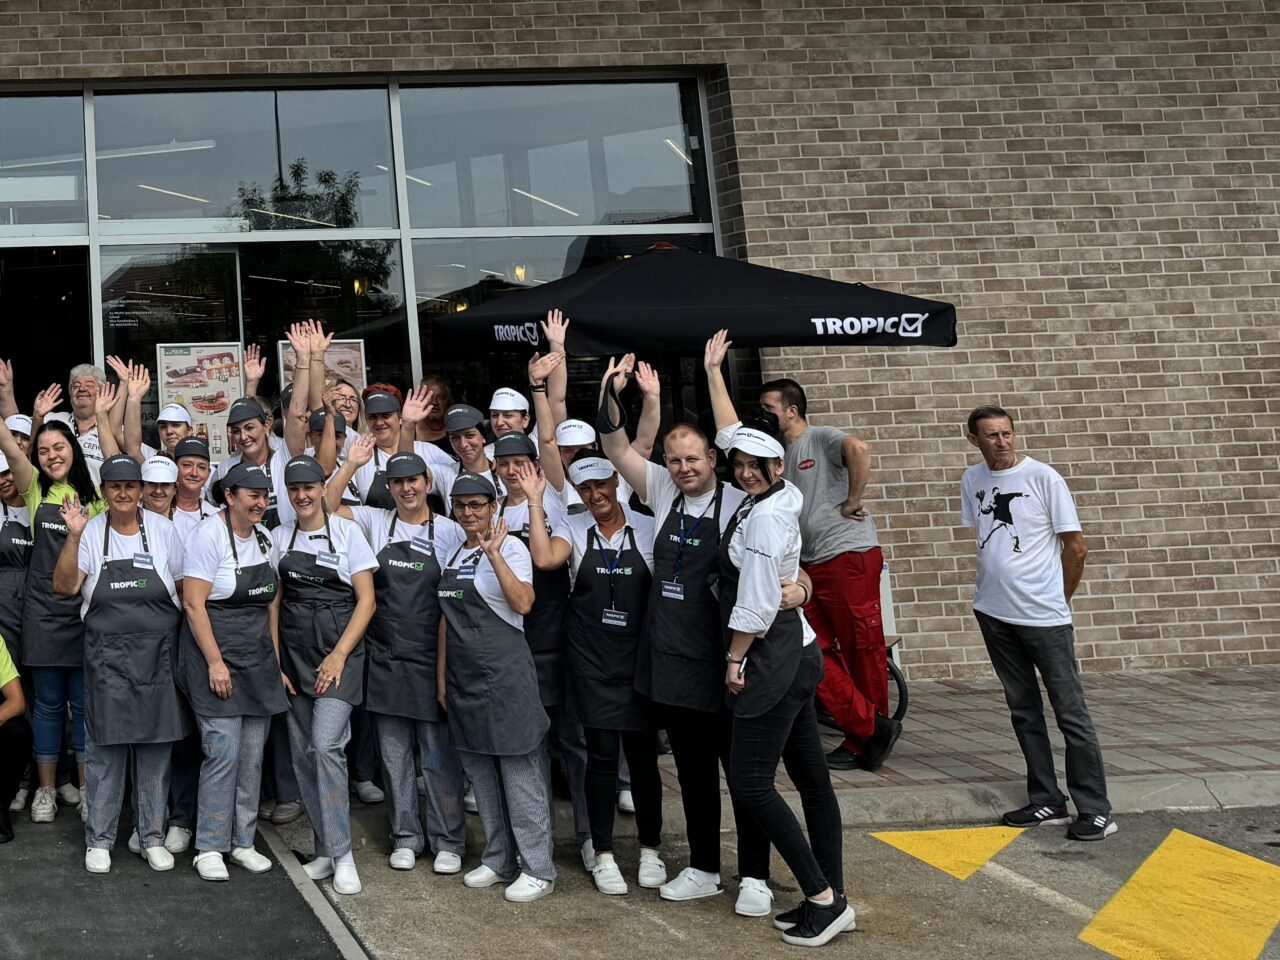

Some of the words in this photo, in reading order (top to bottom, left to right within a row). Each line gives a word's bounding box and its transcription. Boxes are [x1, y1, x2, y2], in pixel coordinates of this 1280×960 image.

[810, 316, 899, 335] TROPIC
[493, 324, 528, 341] TROPIC
[41, 522, 66, 531] TROPIC
[669, 534, 693, 545] TROIC
[388, 559, 415, 569] TROPIC
[110, 580, 138, 589] TROPIC
[248, 585, 269, 596] TROPIC
[437, 590, 457, 598] TROPIC
